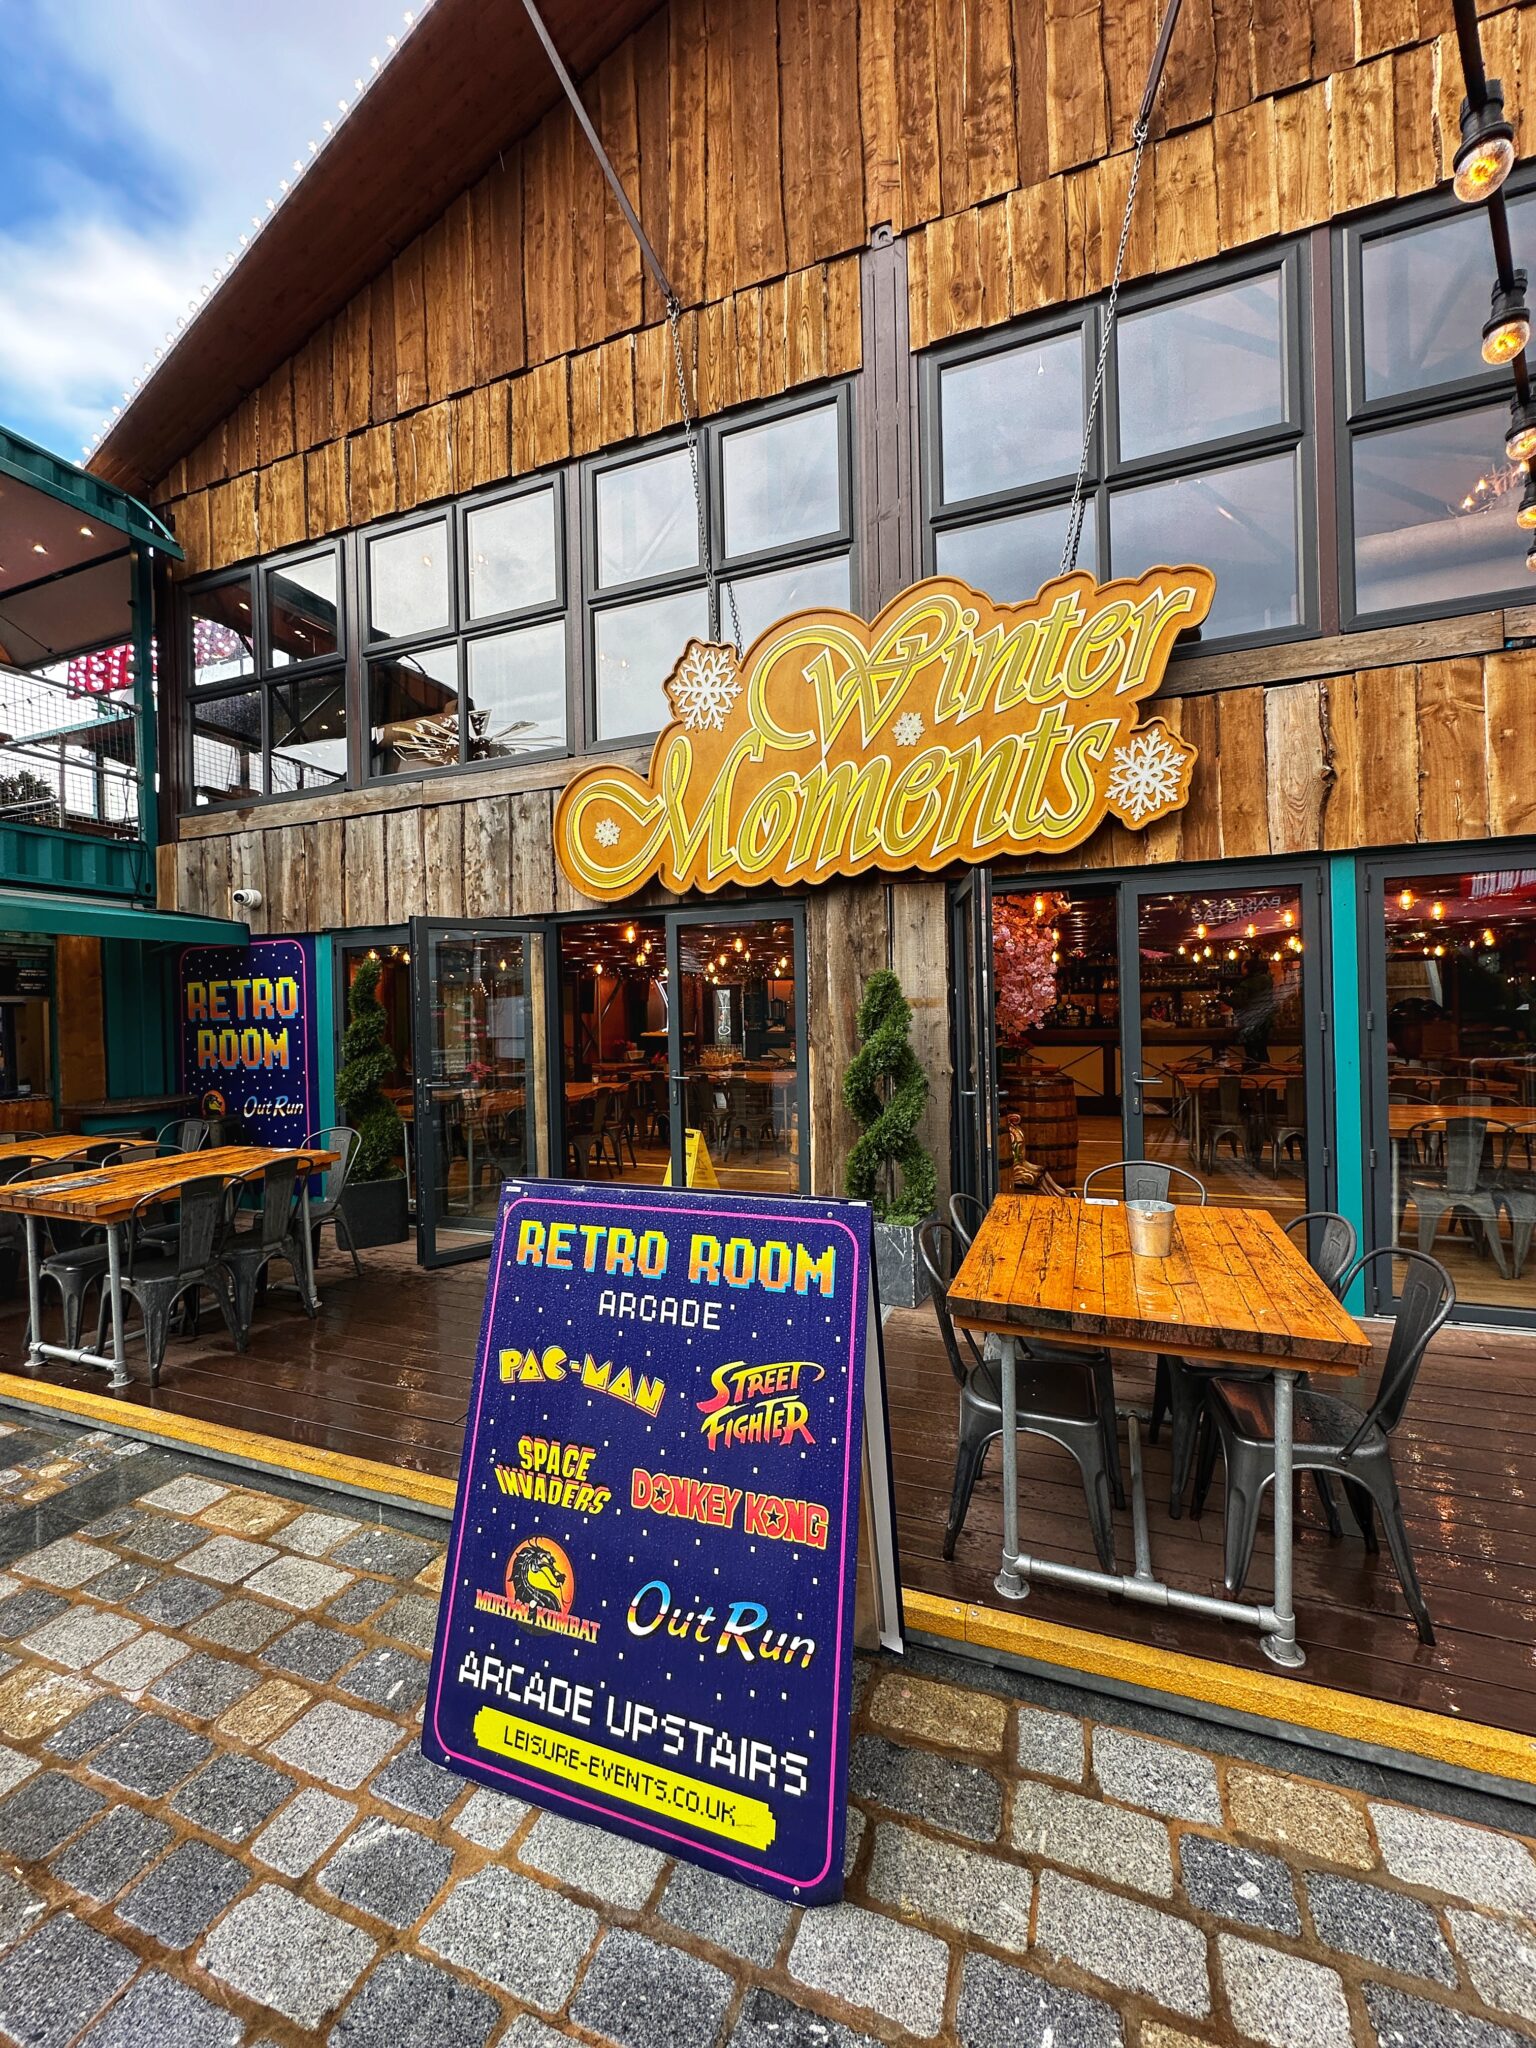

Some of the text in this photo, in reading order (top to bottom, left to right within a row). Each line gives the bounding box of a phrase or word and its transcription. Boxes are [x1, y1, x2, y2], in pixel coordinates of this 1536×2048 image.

[748, 585, 1197, 758] Winter
[568, 702, 1121, 890] Moments
[187, 976, 299, 1022] RETRO
[197, 1027, 290, 1070] ROOM
[516, 1219, 837, 1298] RETRO ROOM
[598, 1289, 723, 1331] ARCADE
[498, 1345, 667, 1418] PAC-MAN
[695, 1360, 826, 1414] STREET
[700, 1395, 817, 1453] FIGHTER
[518, 1435, 597, 1482] SPACE
[494, 1464, 612, 1515] INVADERS
[630, 1468, 830, 1550] DONKEY KONG
[474, 1588, 601, 1644] MORTAL KOMBAT
[458, 1649, 809, 1797] ARCADE UPSTAIRS
[503, 1724, 738, 1828] LEISURE-EVENTS.CO.UK
